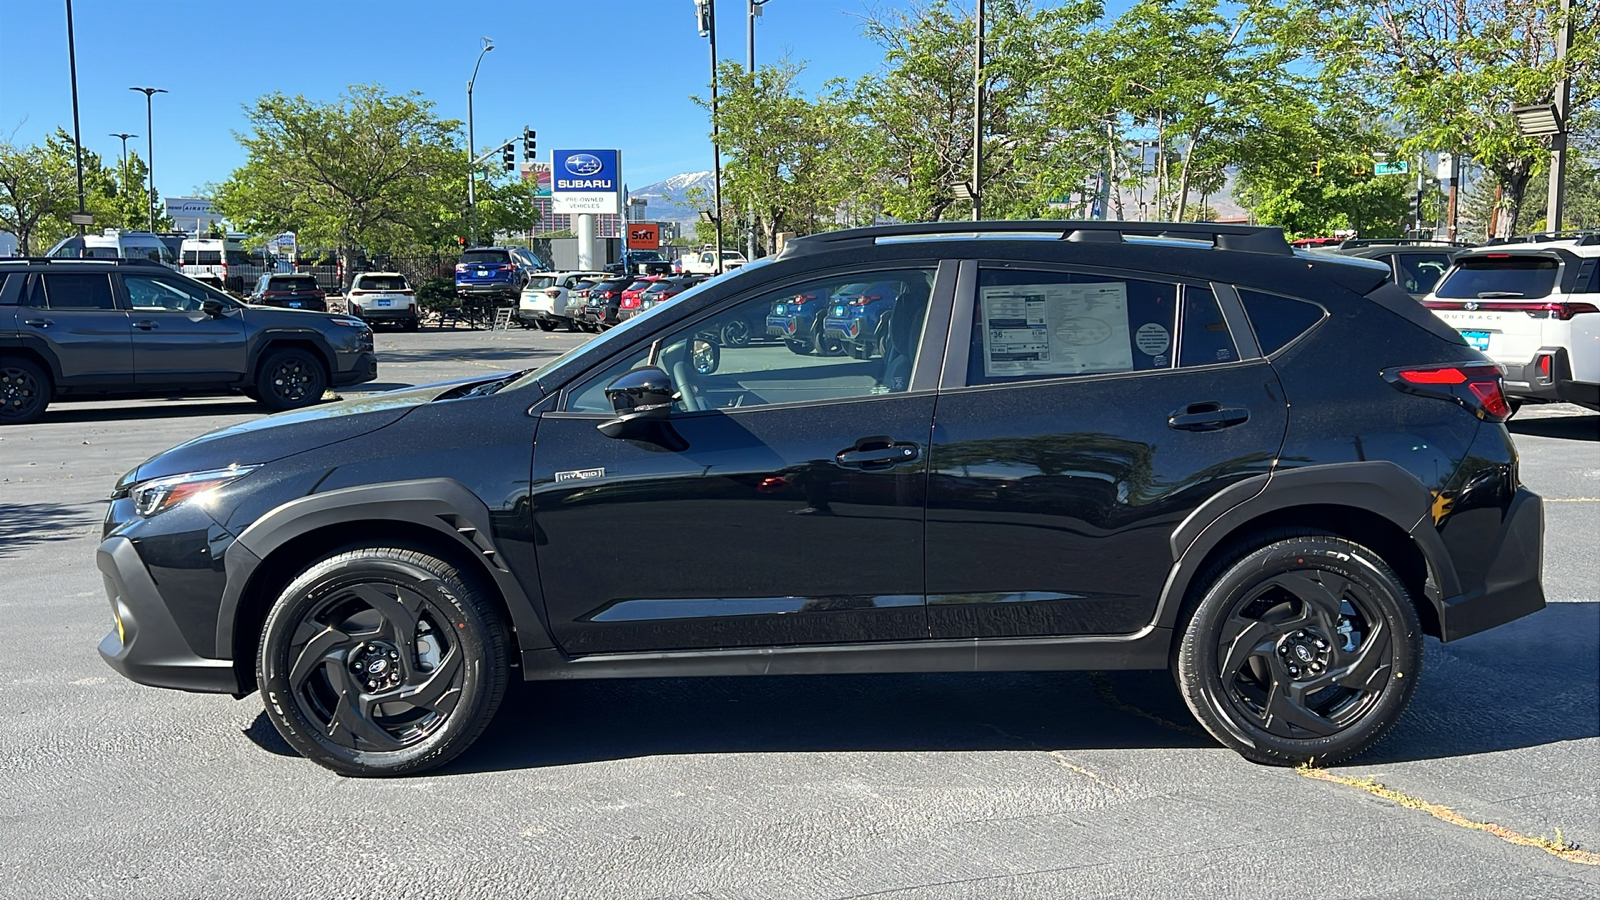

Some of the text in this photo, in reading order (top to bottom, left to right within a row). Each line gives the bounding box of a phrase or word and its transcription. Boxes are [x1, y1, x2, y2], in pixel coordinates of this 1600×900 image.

[557, 180, 612, 189] SUBARU
[993, 331, 1003, 339] 36
[562, 471, 598, 480] HYBRID
